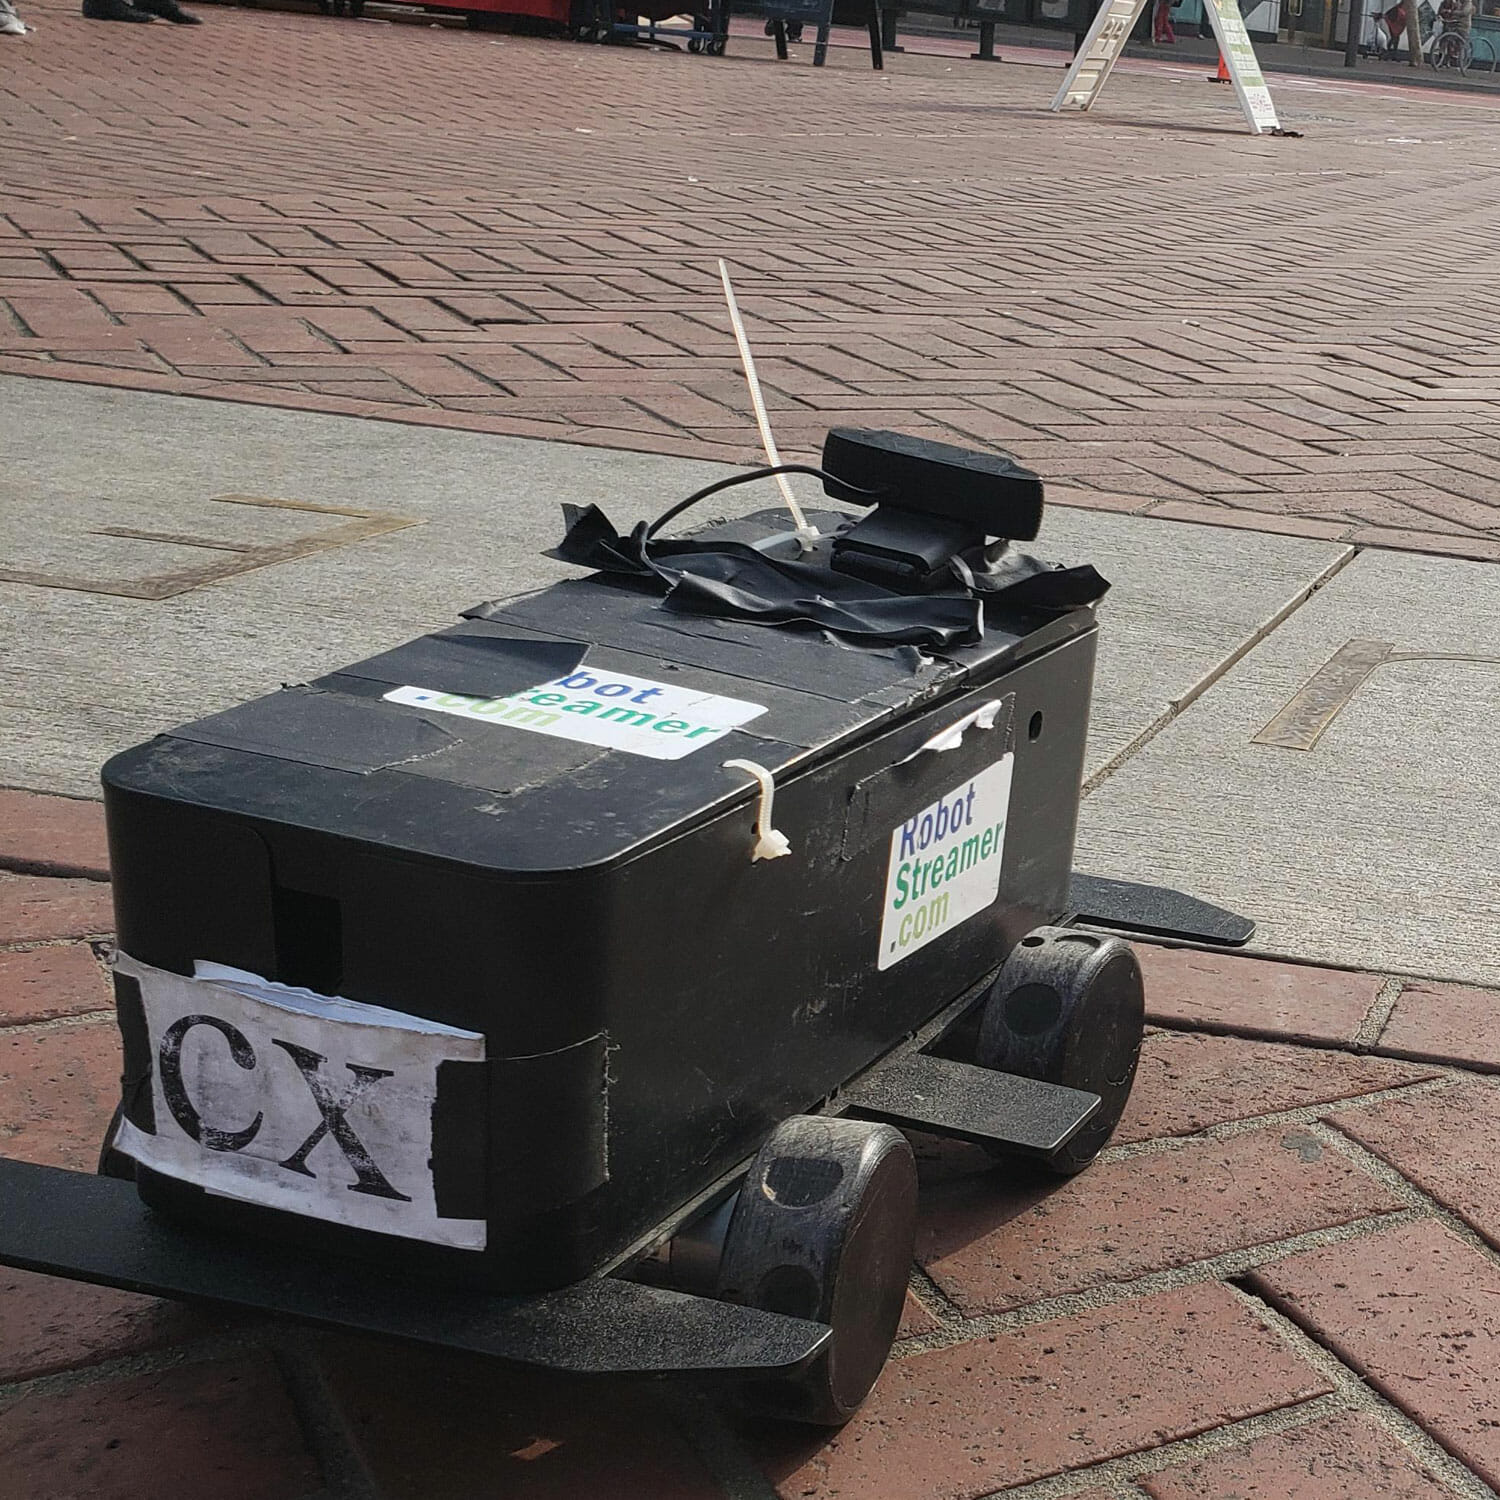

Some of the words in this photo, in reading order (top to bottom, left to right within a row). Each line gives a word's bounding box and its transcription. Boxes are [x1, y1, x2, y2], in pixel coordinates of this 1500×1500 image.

[415, 694, 562, 727] .com
[512, 688, 721, 739] eamer
[553, 671, 664, 704] bot
[899, 783, 976, 862] Robot
[893, 821, 1004, 910] Streamer
[889, 891, 950, 954] .com
[159, 1014, 413, 1203] CX
